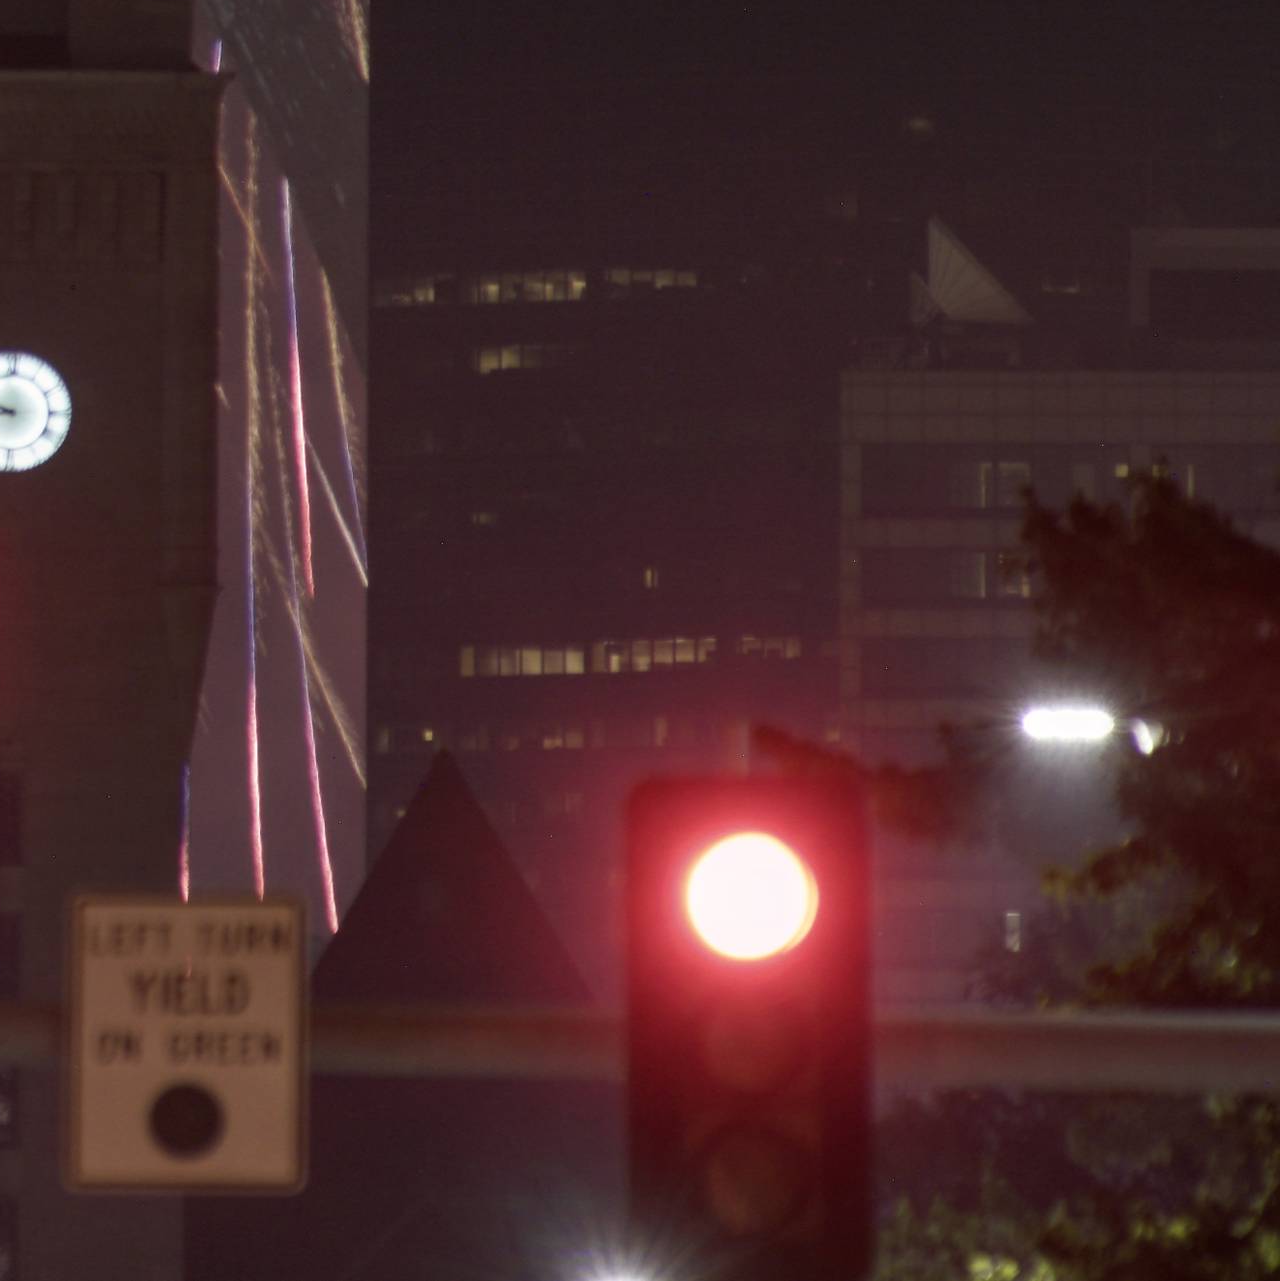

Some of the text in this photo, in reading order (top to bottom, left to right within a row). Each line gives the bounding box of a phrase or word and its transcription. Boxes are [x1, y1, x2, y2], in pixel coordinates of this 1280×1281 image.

[90, 921, 290, 957] LEFT TURN
[128, 970, 252, 1017] YIELD
[96, 1029, 283, 1067] ON GREEN
